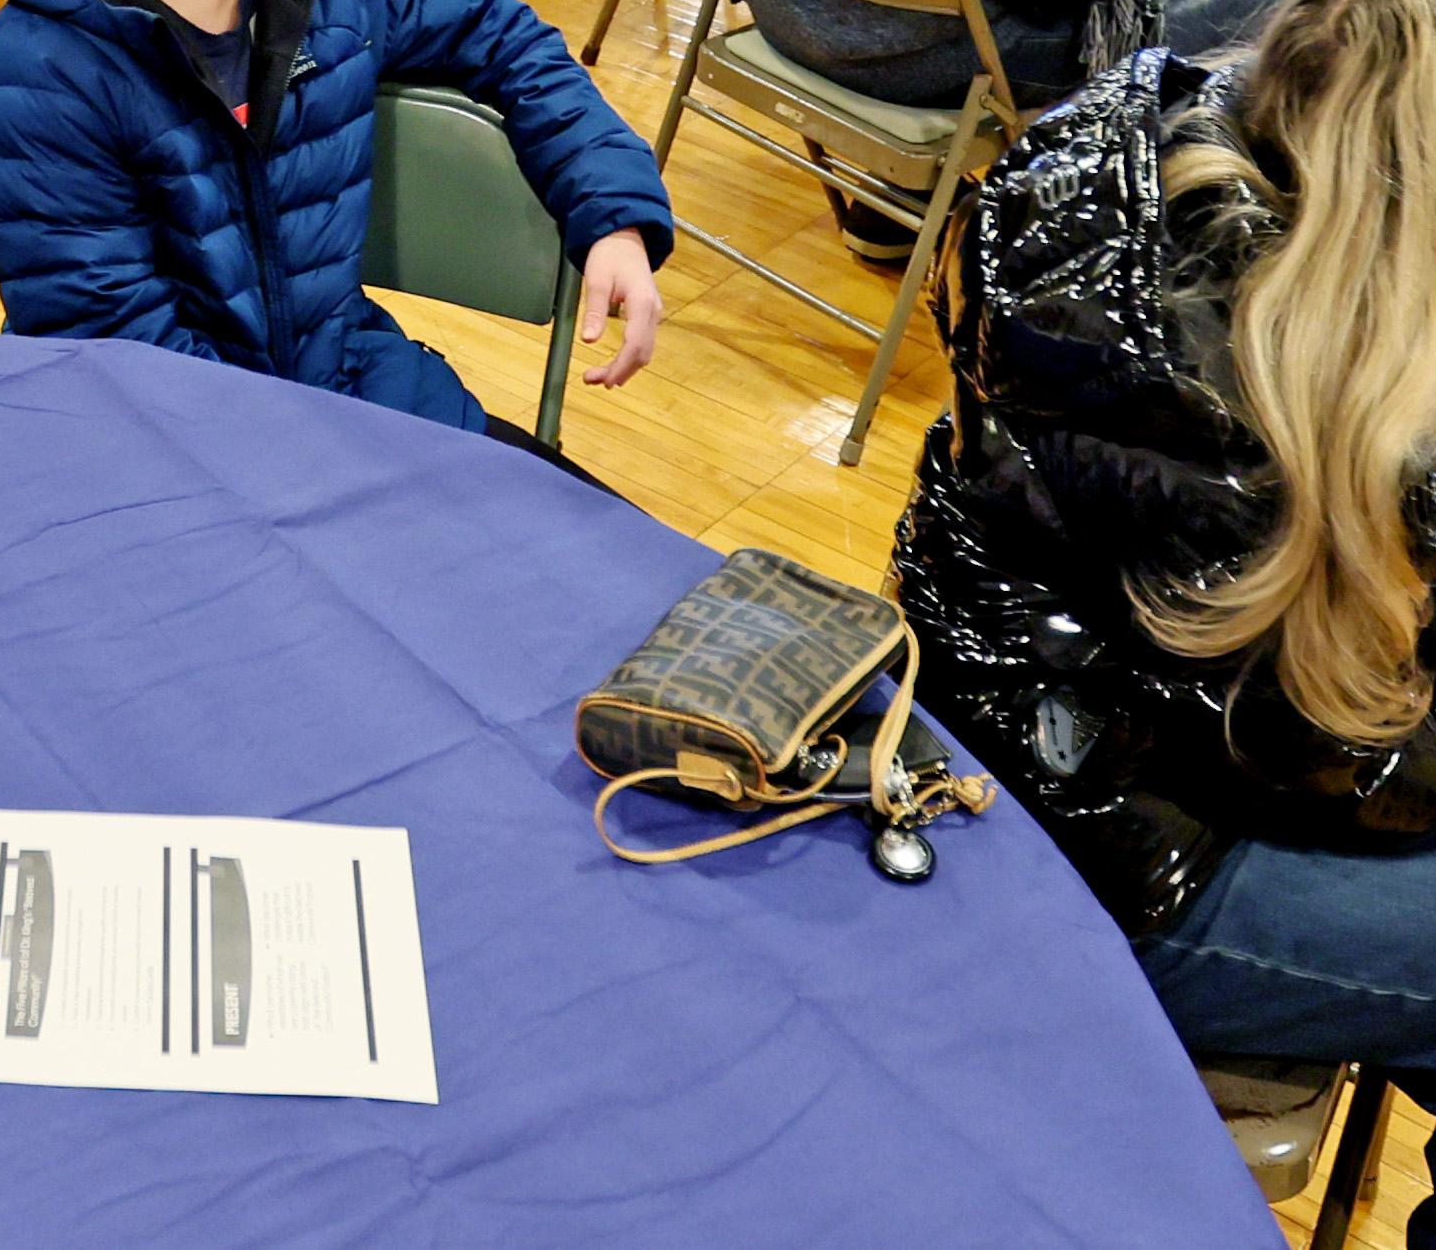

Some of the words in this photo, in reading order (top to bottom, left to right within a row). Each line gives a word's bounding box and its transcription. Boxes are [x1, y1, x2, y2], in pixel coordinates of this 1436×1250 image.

[17, 969, 28, 992] Pillars
[16, 993, 27, 1010] Five
[224, 982, 239, 1035] PRESENT
[14, 1010, 26, 1026] The
